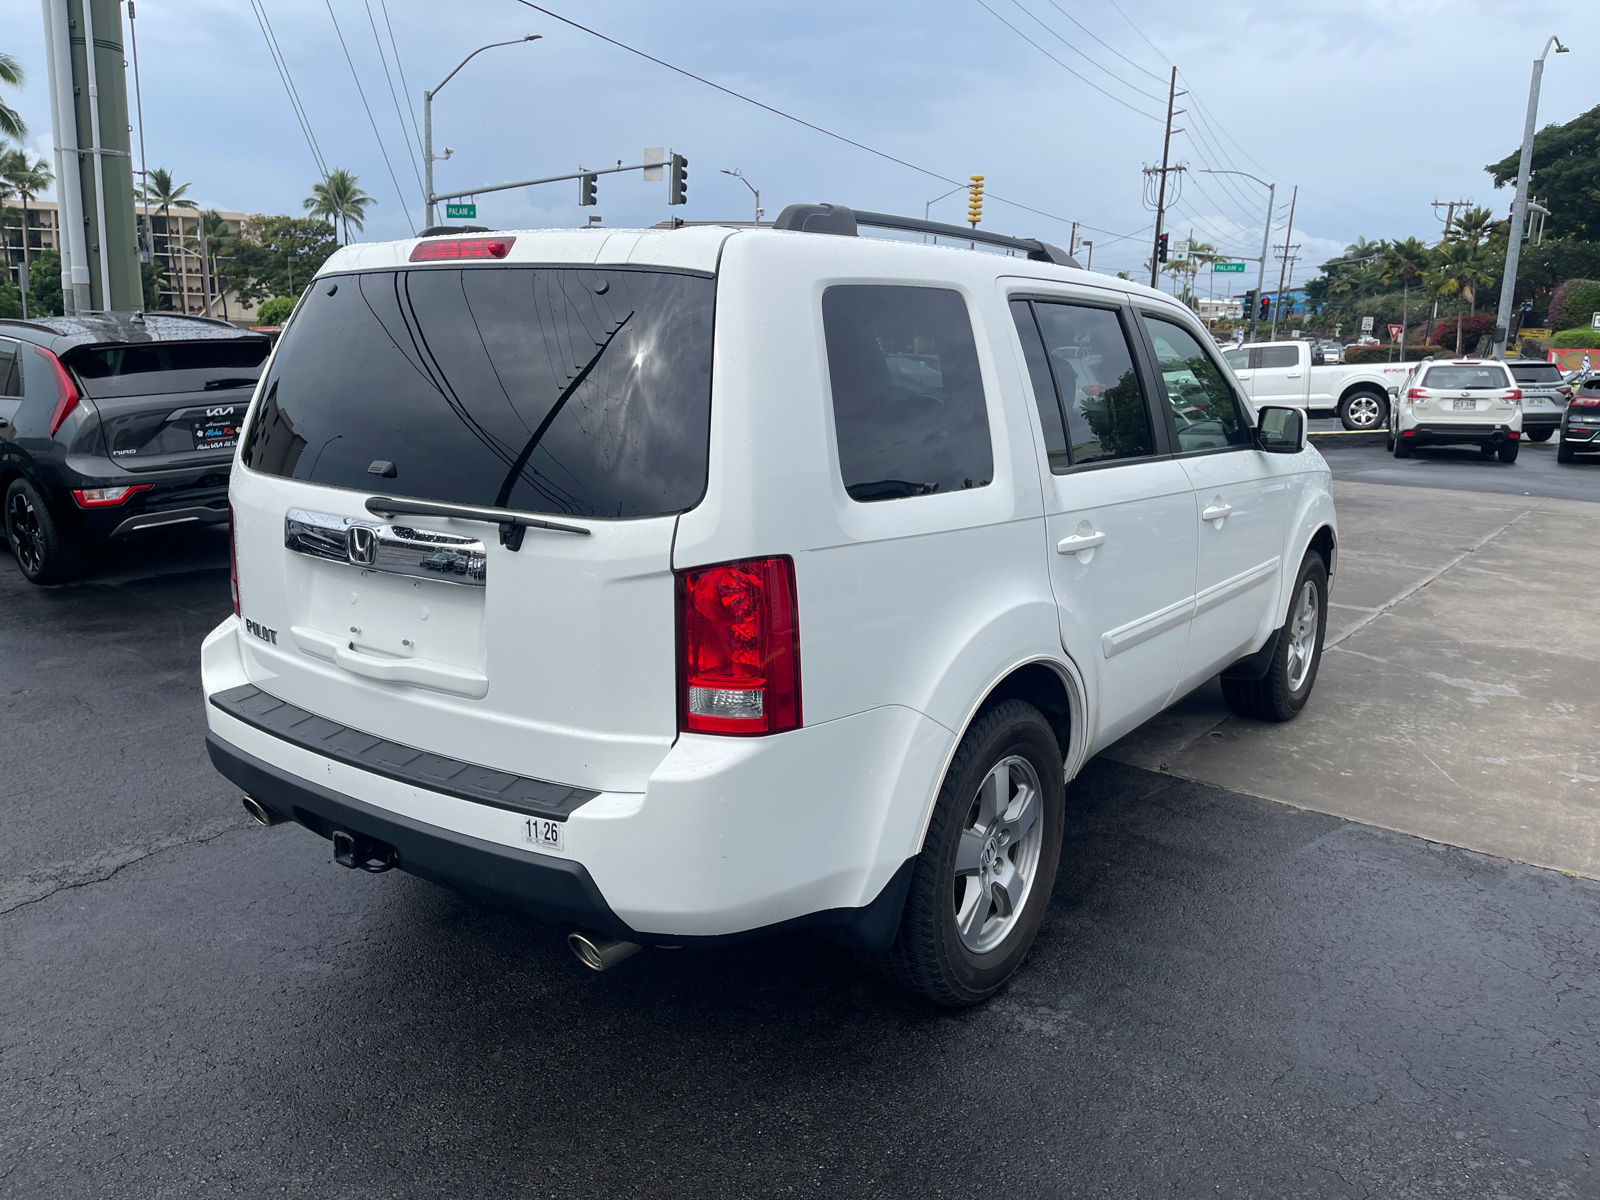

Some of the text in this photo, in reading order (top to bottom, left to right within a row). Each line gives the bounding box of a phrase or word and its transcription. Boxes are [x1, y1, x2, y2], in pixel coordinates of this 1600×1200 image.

[448, 207, 468, 215] PALANI
[206, 406, 234, 417] KIA
[205, 427, 235, 437] Aloha Kia
[246, 617, 278, 646] PILOT
[526, 819, 558, 841] 11 26
